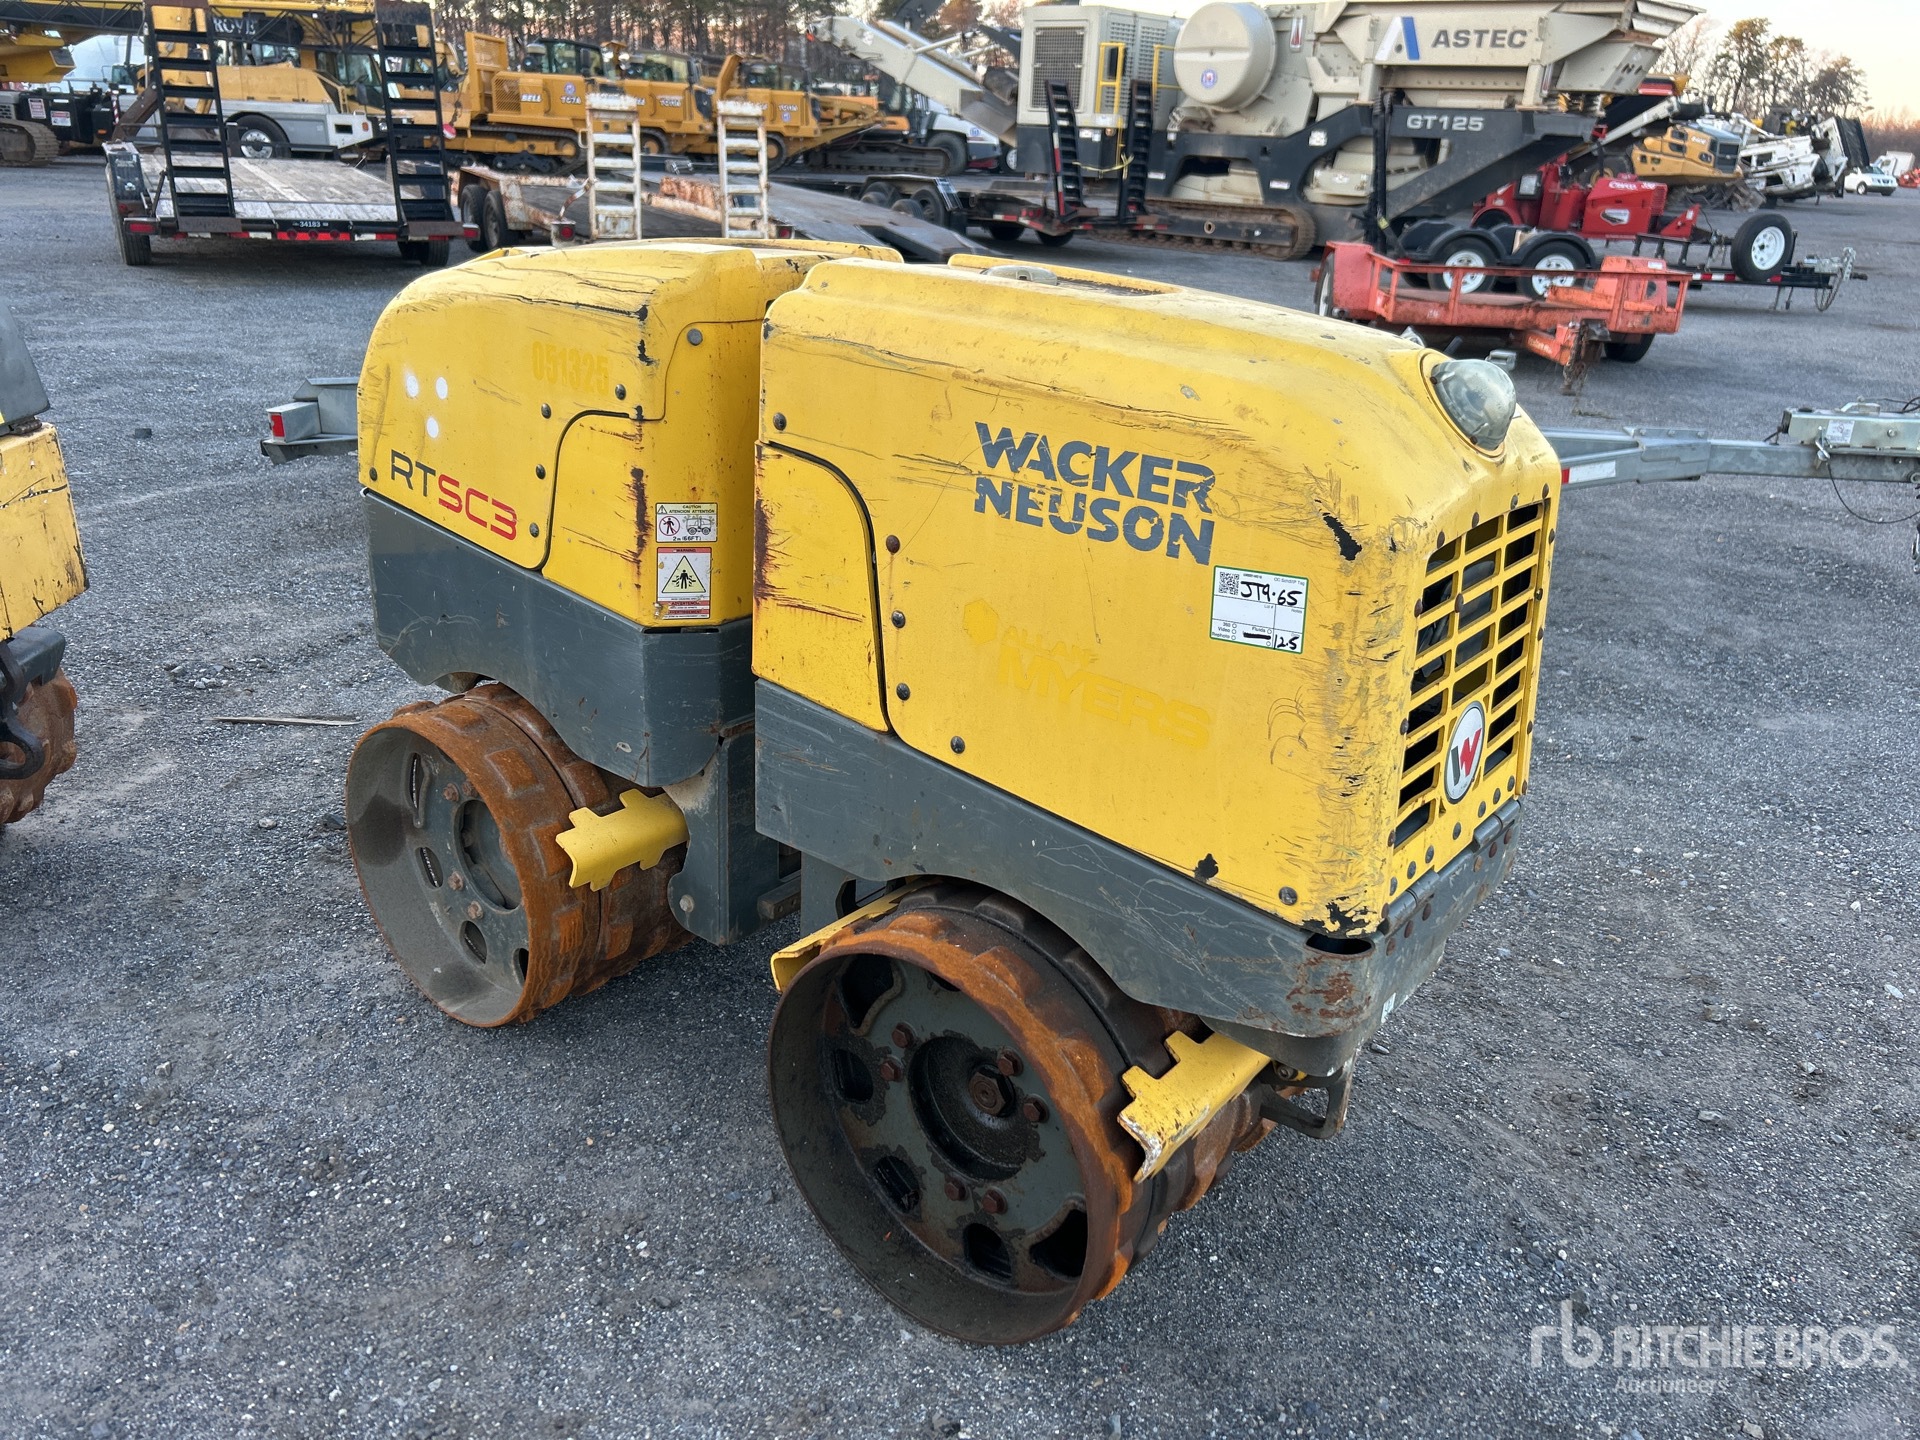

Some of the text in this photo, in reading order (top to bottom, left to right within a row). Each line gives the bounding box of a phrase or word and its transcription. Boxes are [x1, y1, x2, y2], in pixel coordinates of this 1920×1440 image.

[212, 17, 256, 35] ROVE
[1431, 29, 1527, 48] ASTEC
[521, 94, 542, 102] BELL
[1406, 114, 1485, 132] GT125
[532, 341, 609, 396] 051325
[391, 449, 517, 541] RTSC3
[975, 421, 1216, 514] WACKER
[974, 476, 1215, 566] NEUSON
[998, 646, 1212, 749] MYERS
